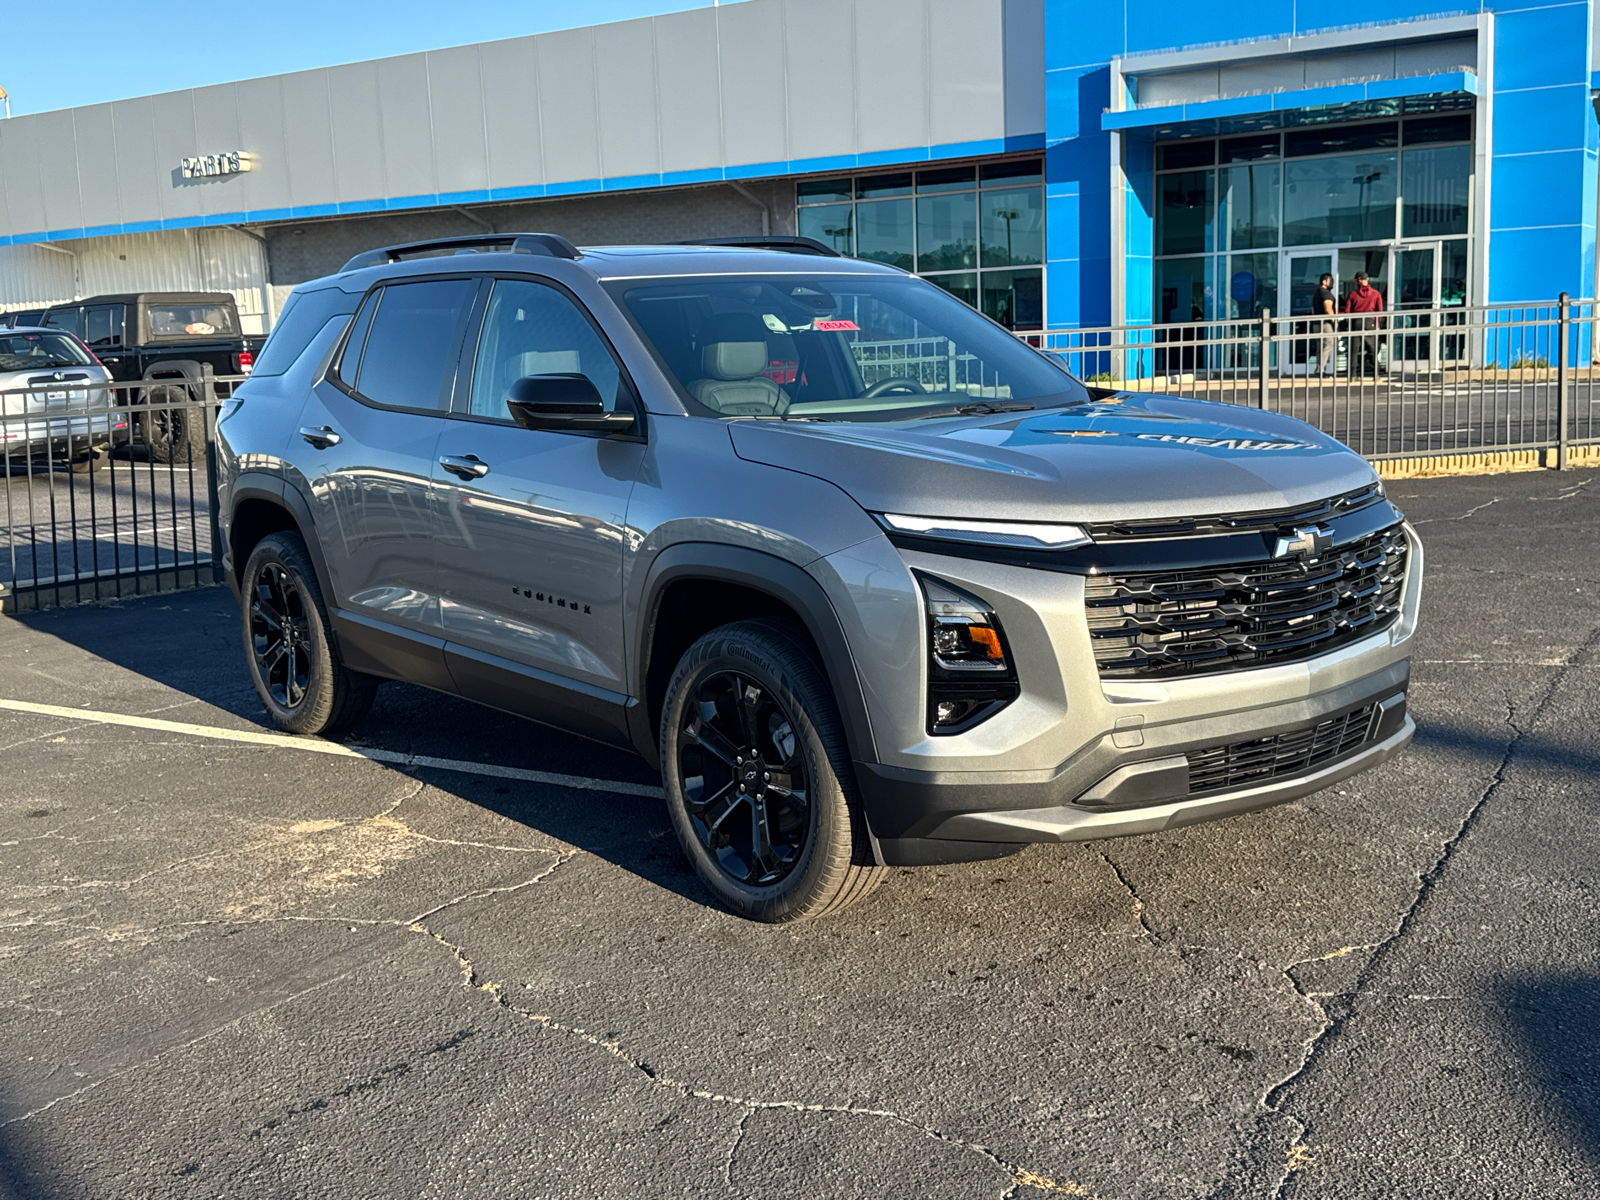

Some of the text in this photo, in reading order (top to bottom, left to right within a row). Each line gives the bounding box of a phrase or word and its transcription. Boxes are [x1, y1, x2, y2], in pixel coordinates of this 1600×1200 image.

[180, 151, 241, 178] PARTS
[512, 586, 591, 615] EQUINOX
[727, 642, 771, 673] Continental
